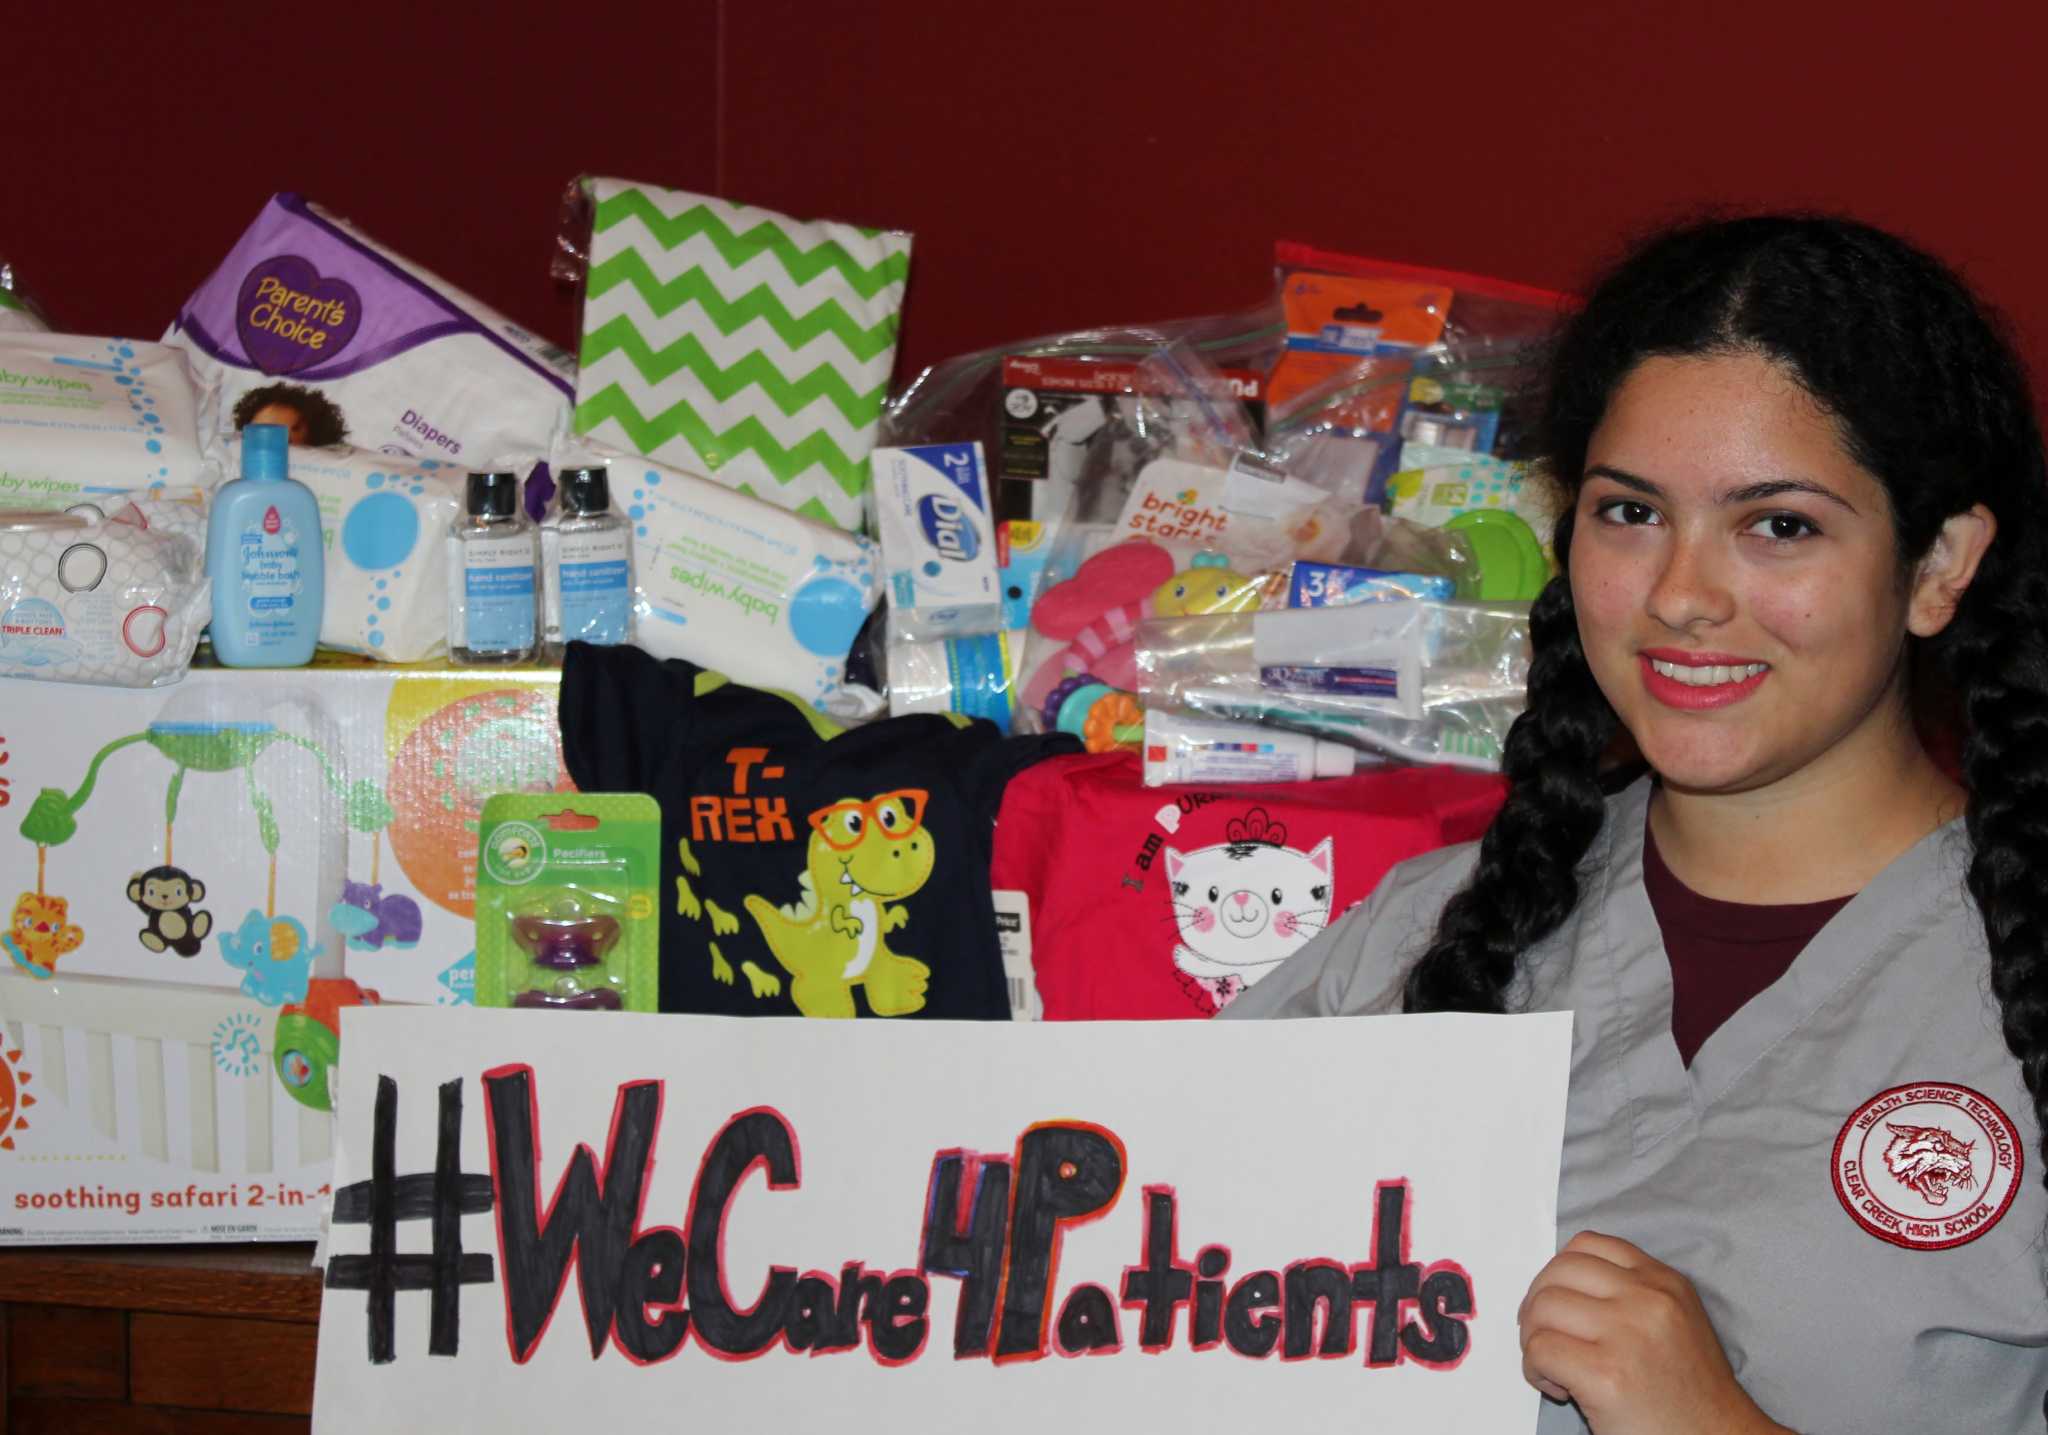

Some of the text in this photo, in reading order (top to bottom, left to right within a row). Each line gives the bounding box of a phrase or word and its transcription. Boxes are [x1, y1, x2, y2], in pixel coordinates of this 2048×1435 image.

[255, 276, 346, 326] Parent's
[249, 303, 327, 350] Choice
[0, 368, 93, 393] by wipes
[401, 409, 462, 455] Diapers
[0, 471, 80, 495] by wipes
[931, 496, 969, 561] Dial
[1142, 493, 1228, 530] bright
[671, 564, 779, 626] baby wipes
[2, 625, 64, 636] TRIPLE CLEAN
[725, 747, 785, 795] T-
[690, 795, 795, 842] REX
[552, 848, 607, 860] Pacifiers
[1122, 873, 1145, 893] I
[1136, 833, 1164, 871] am
[1855, 1089, 2013, 1170] HEALTH SCIENCE TECHNOLOGY
[15, 1185, 140, 1215] soothing
[151, 1184, 237, 1207] safari
[325, 1063, 1476, 1371] #WeCare4Patients
[1843, 1159, 1994, 1237] CLEAR CREEK HIGH SCHOOL
